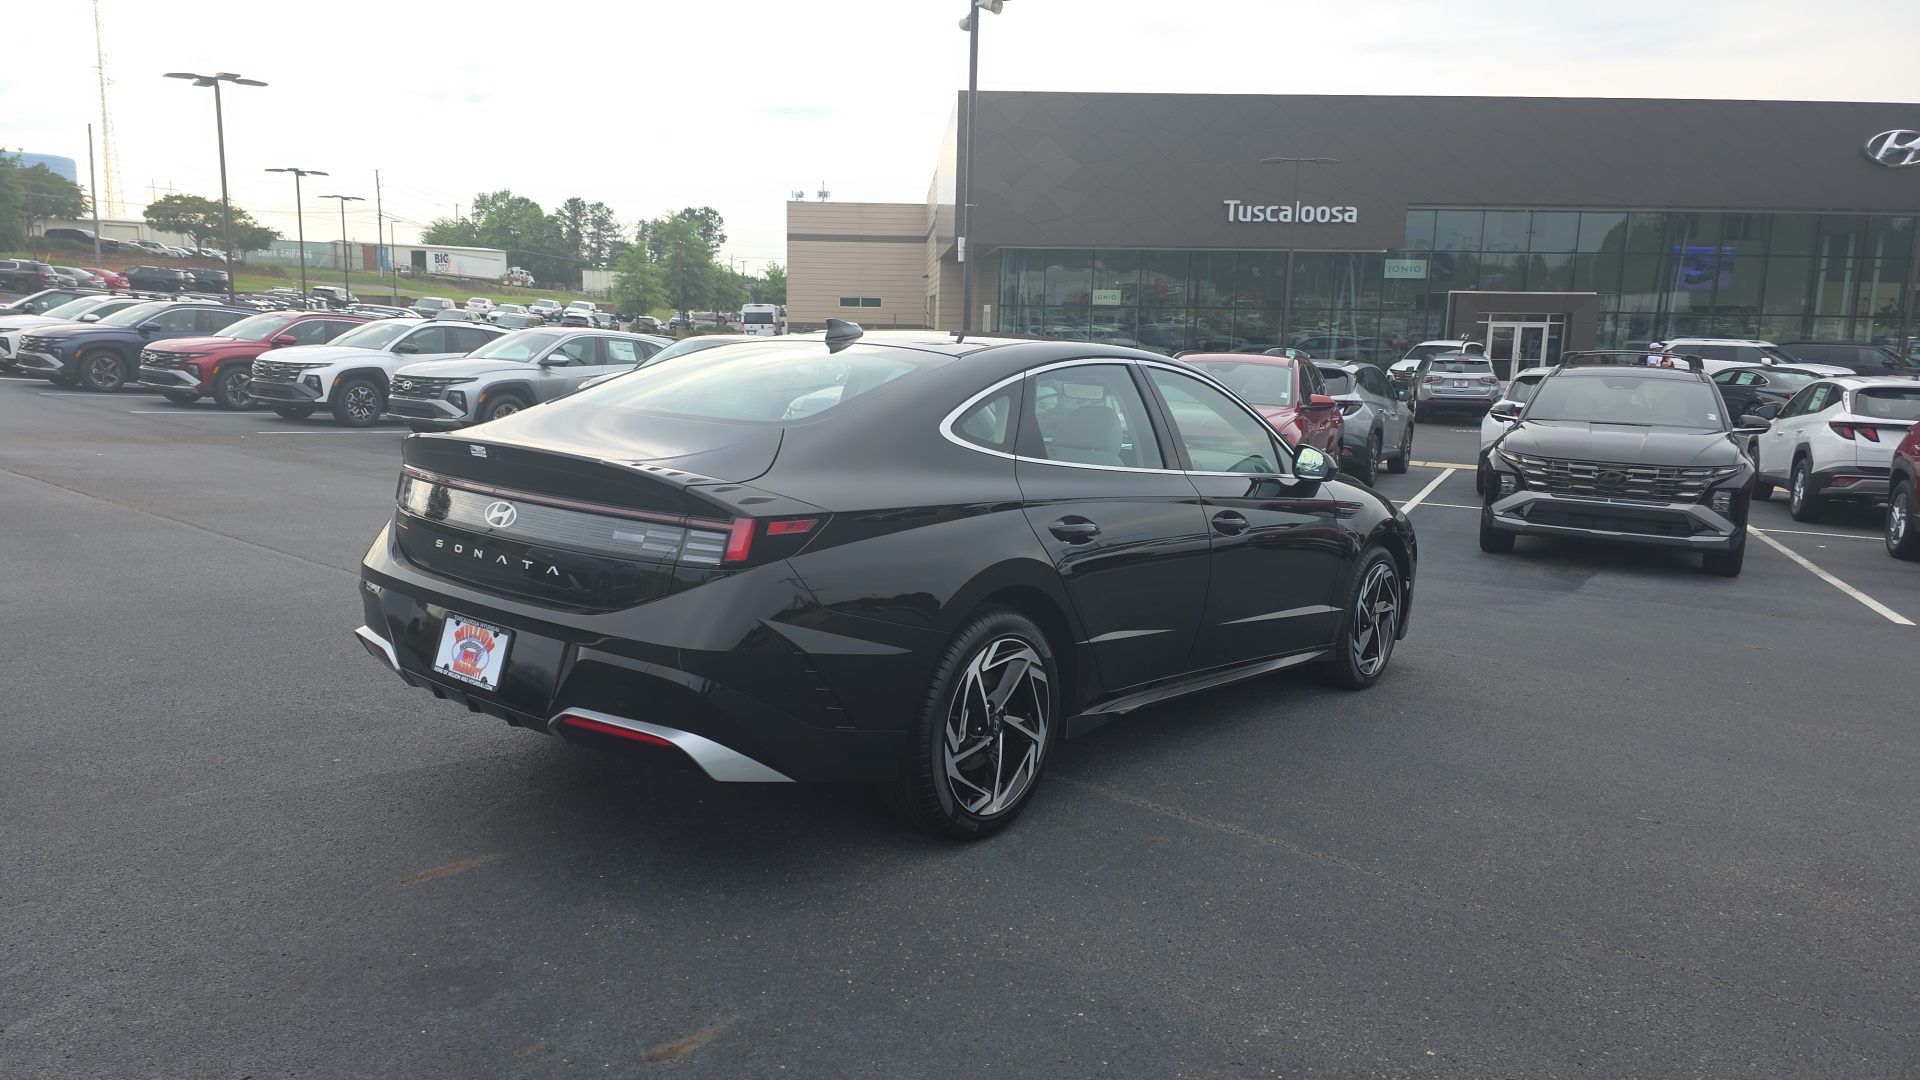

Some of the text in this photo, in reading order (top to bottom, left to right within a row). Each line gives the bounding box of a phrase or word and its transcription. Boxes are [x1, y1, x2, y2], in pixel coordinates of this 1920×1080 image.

[1223, 200, 1358, 223] Tuscaloosa
[280, 248, 313, 259] SHIPPNG
[434, 253, 449, 264] BIG
[435, 539, 560, 576] SONATA
[454, 614, 500, 632] TUSCALOOSA HYUNDAI
[454, 625, 495, 653] MILLION
[462, 649, 479, 667] MILE
[453, 661, 482, 680] WARRANTY
